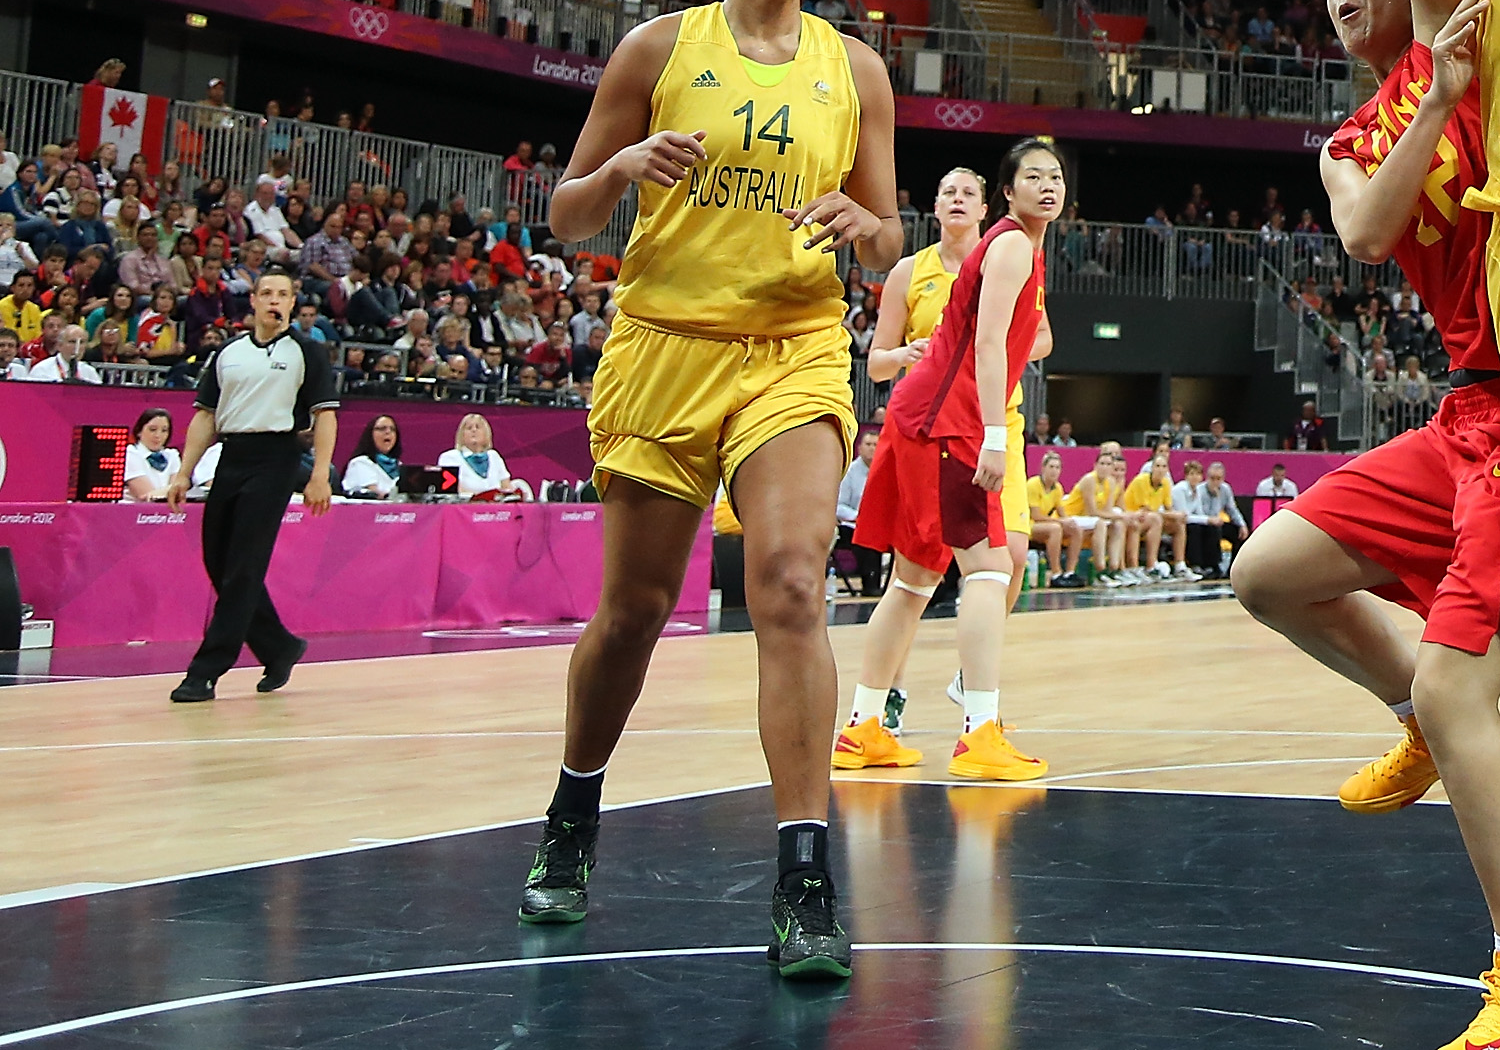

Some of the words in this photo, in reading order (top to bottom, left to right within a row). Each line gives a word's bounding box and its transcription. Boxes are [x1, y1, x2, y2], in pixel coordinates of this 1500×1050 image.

[532, 54, 580, 81] London
[691, 80, 721, 88] adidas
[733, 100, 794, 156] 14
[87, 428, 128, 499] 3
